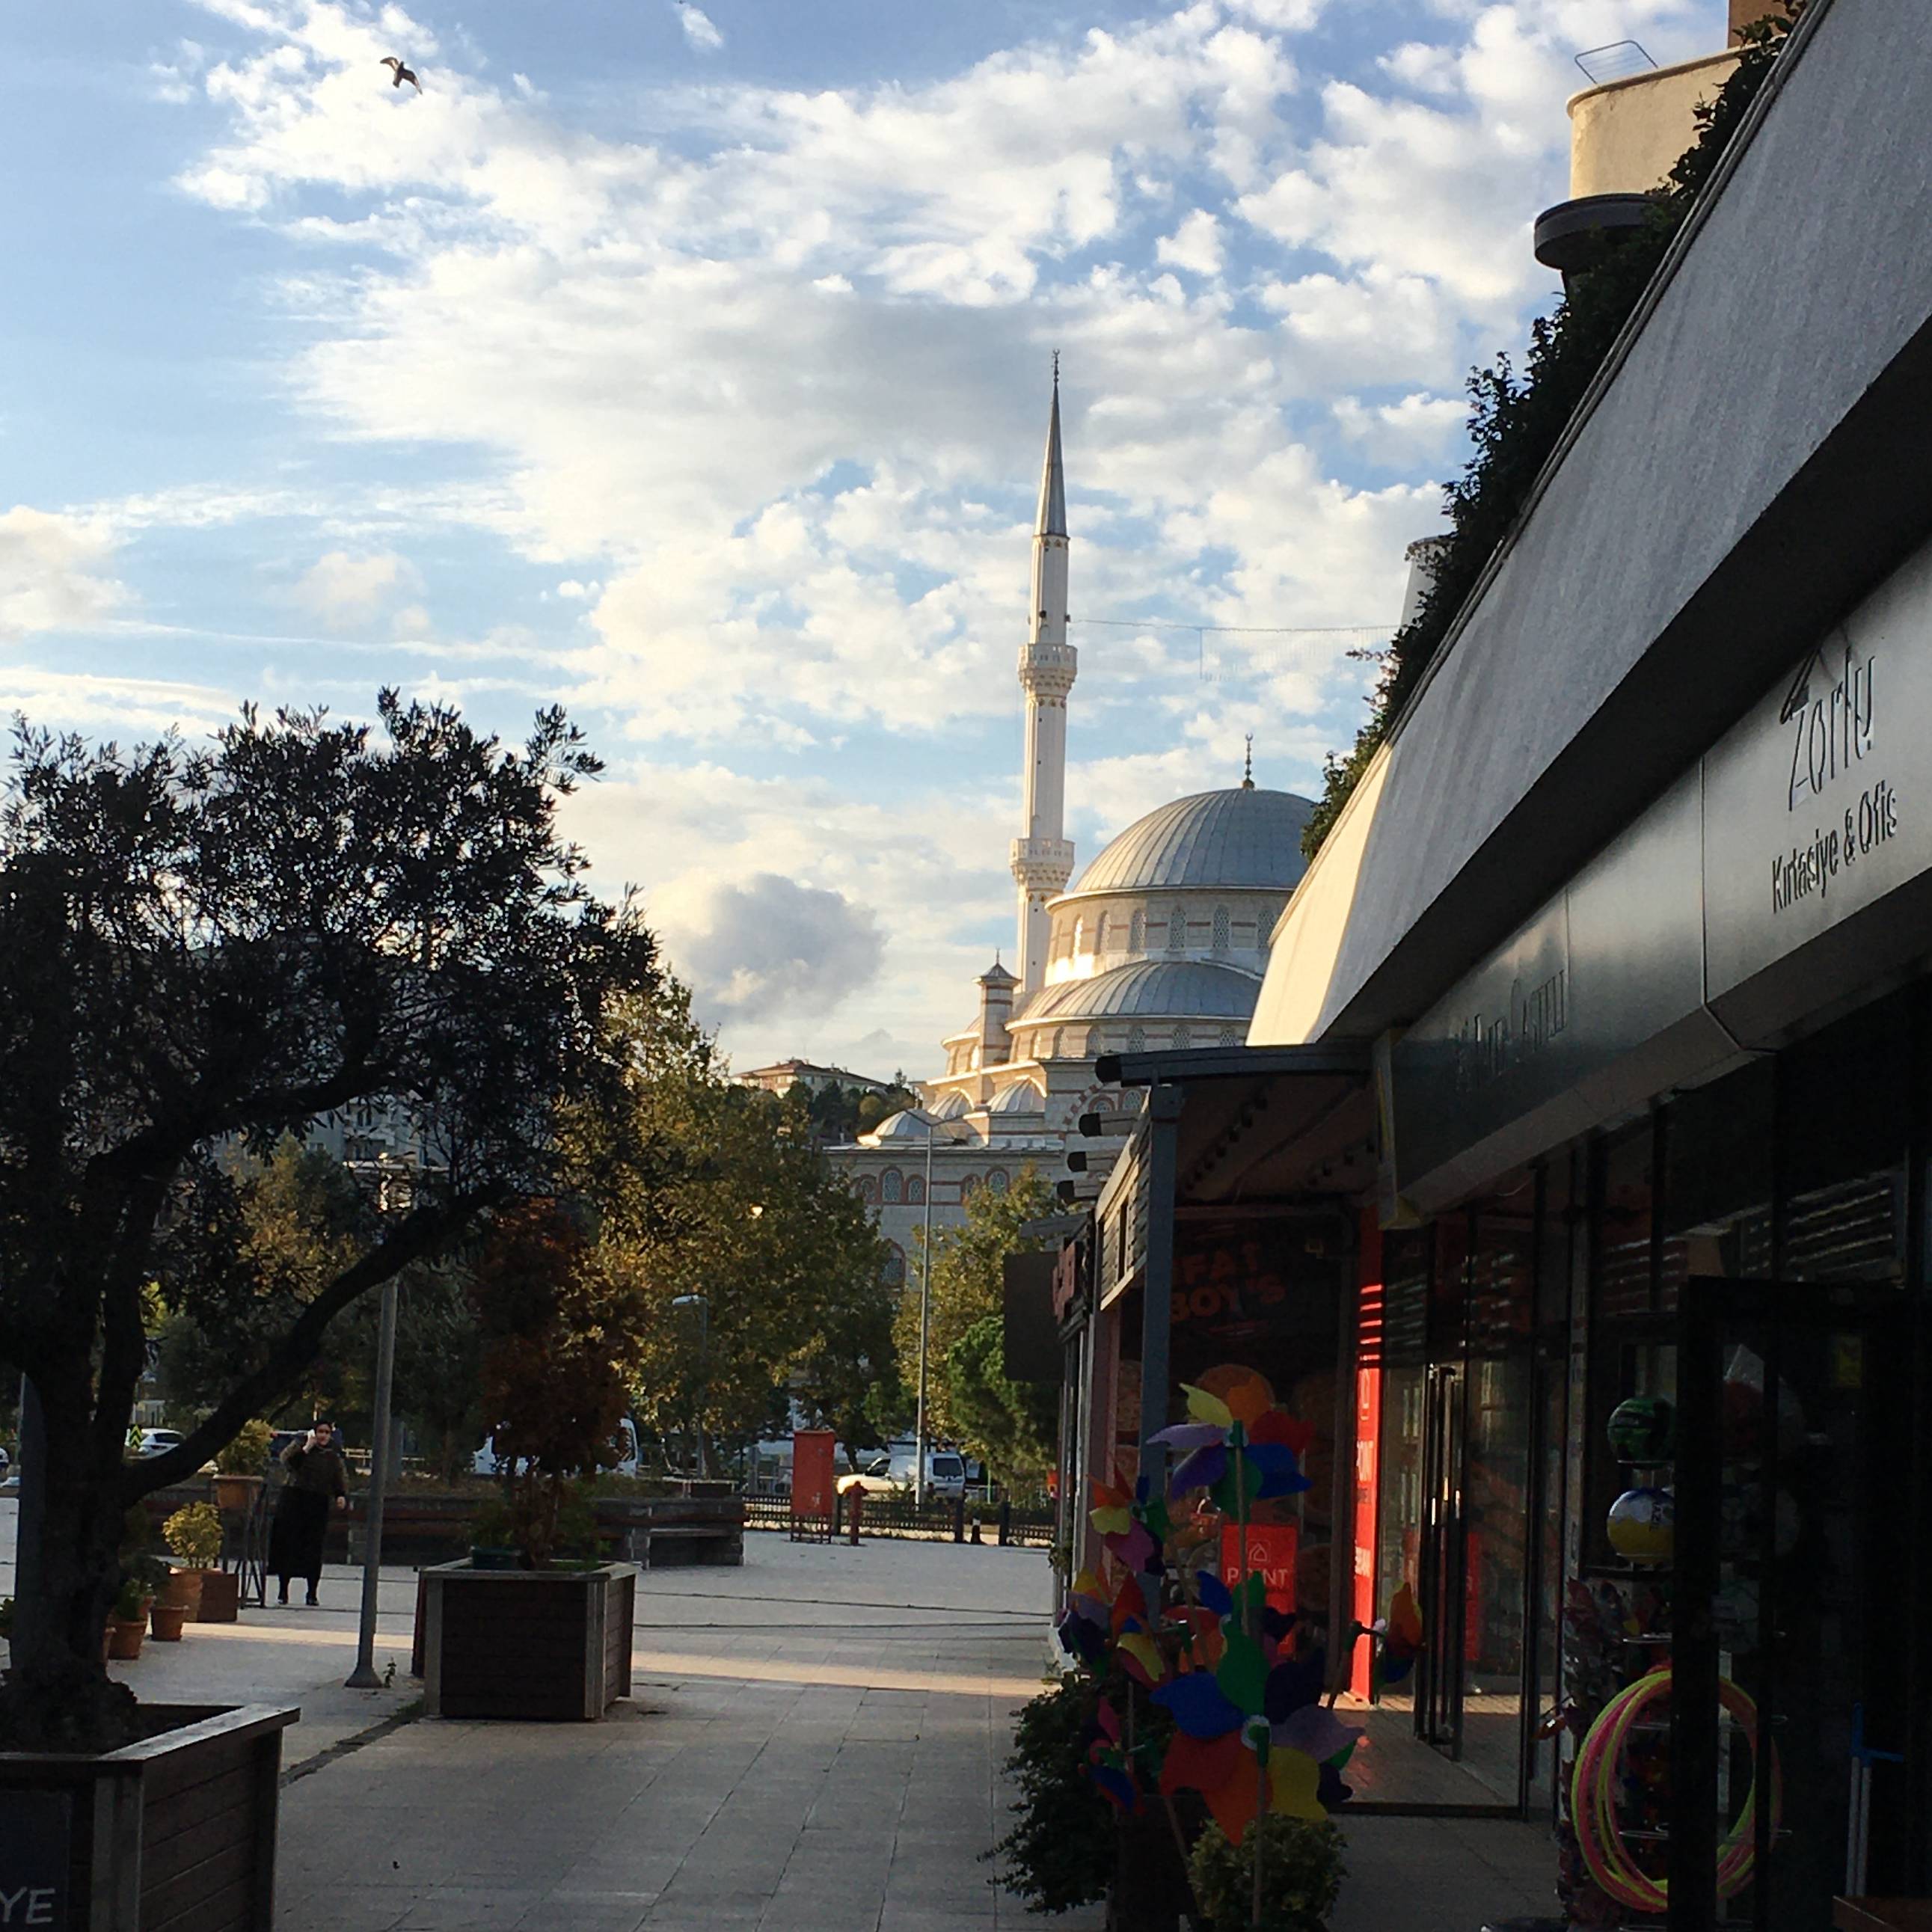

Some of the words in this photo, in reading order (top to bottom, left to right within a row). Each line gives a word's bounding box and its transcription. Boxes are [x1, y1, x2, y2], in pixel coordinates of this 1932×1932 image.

[1789, 645, 1876, 811] Zorlu
[1772, 828, 1839, 913] Kırtasiye
[1844, 808, 1856, 866] &
[1859, 780, 1898, 854] Ofis
[1227, 1566, 1289, 1587] PNT
